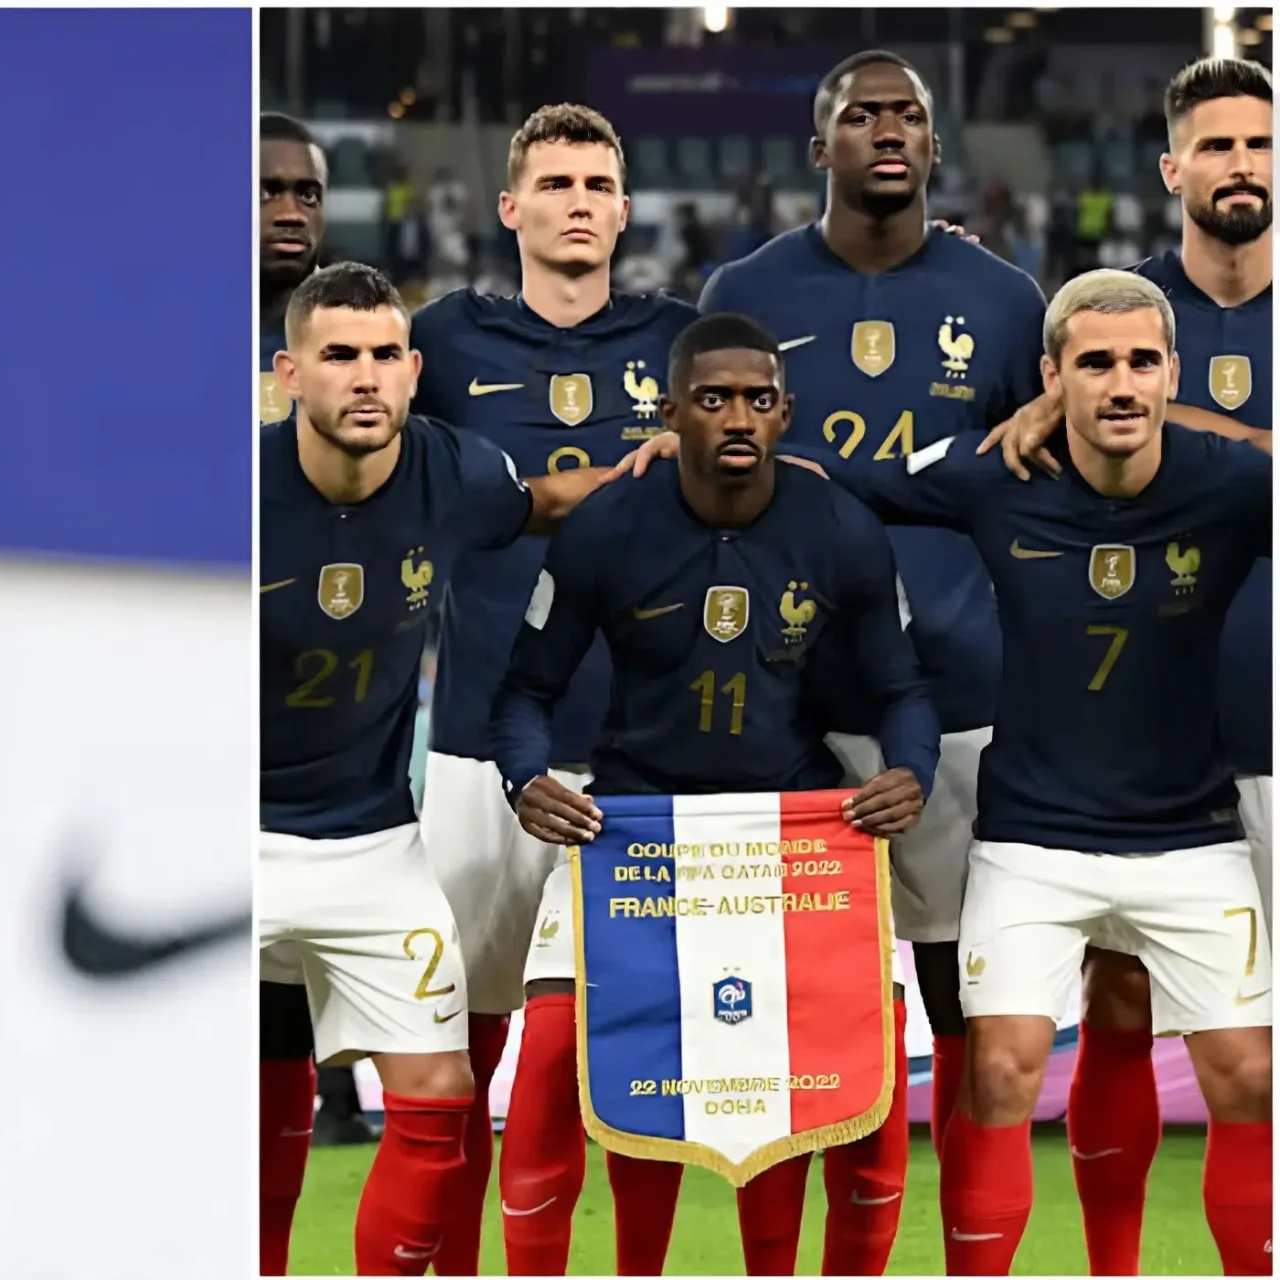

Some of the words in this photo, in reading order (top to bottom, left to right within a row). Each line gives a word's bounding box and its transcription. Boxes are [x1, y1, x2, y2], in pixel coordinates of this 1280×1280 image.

[822, 410, 914, 461] 24
[285, 648, 374, 707] 21
[1086, 625, 1129, 691] 7
[689, 669, 746, 735] 11
[614, 865, 641, 881] DE
[644, 865, 671, 881] LA
[710, 842, 741, 858] DU
[402, 927, 456, 1001] 2
[1223, 906, 1258, 979] 7
[629, 1080, 657, 1096] 22
[704, 1099, 767, 1115] DOHA
